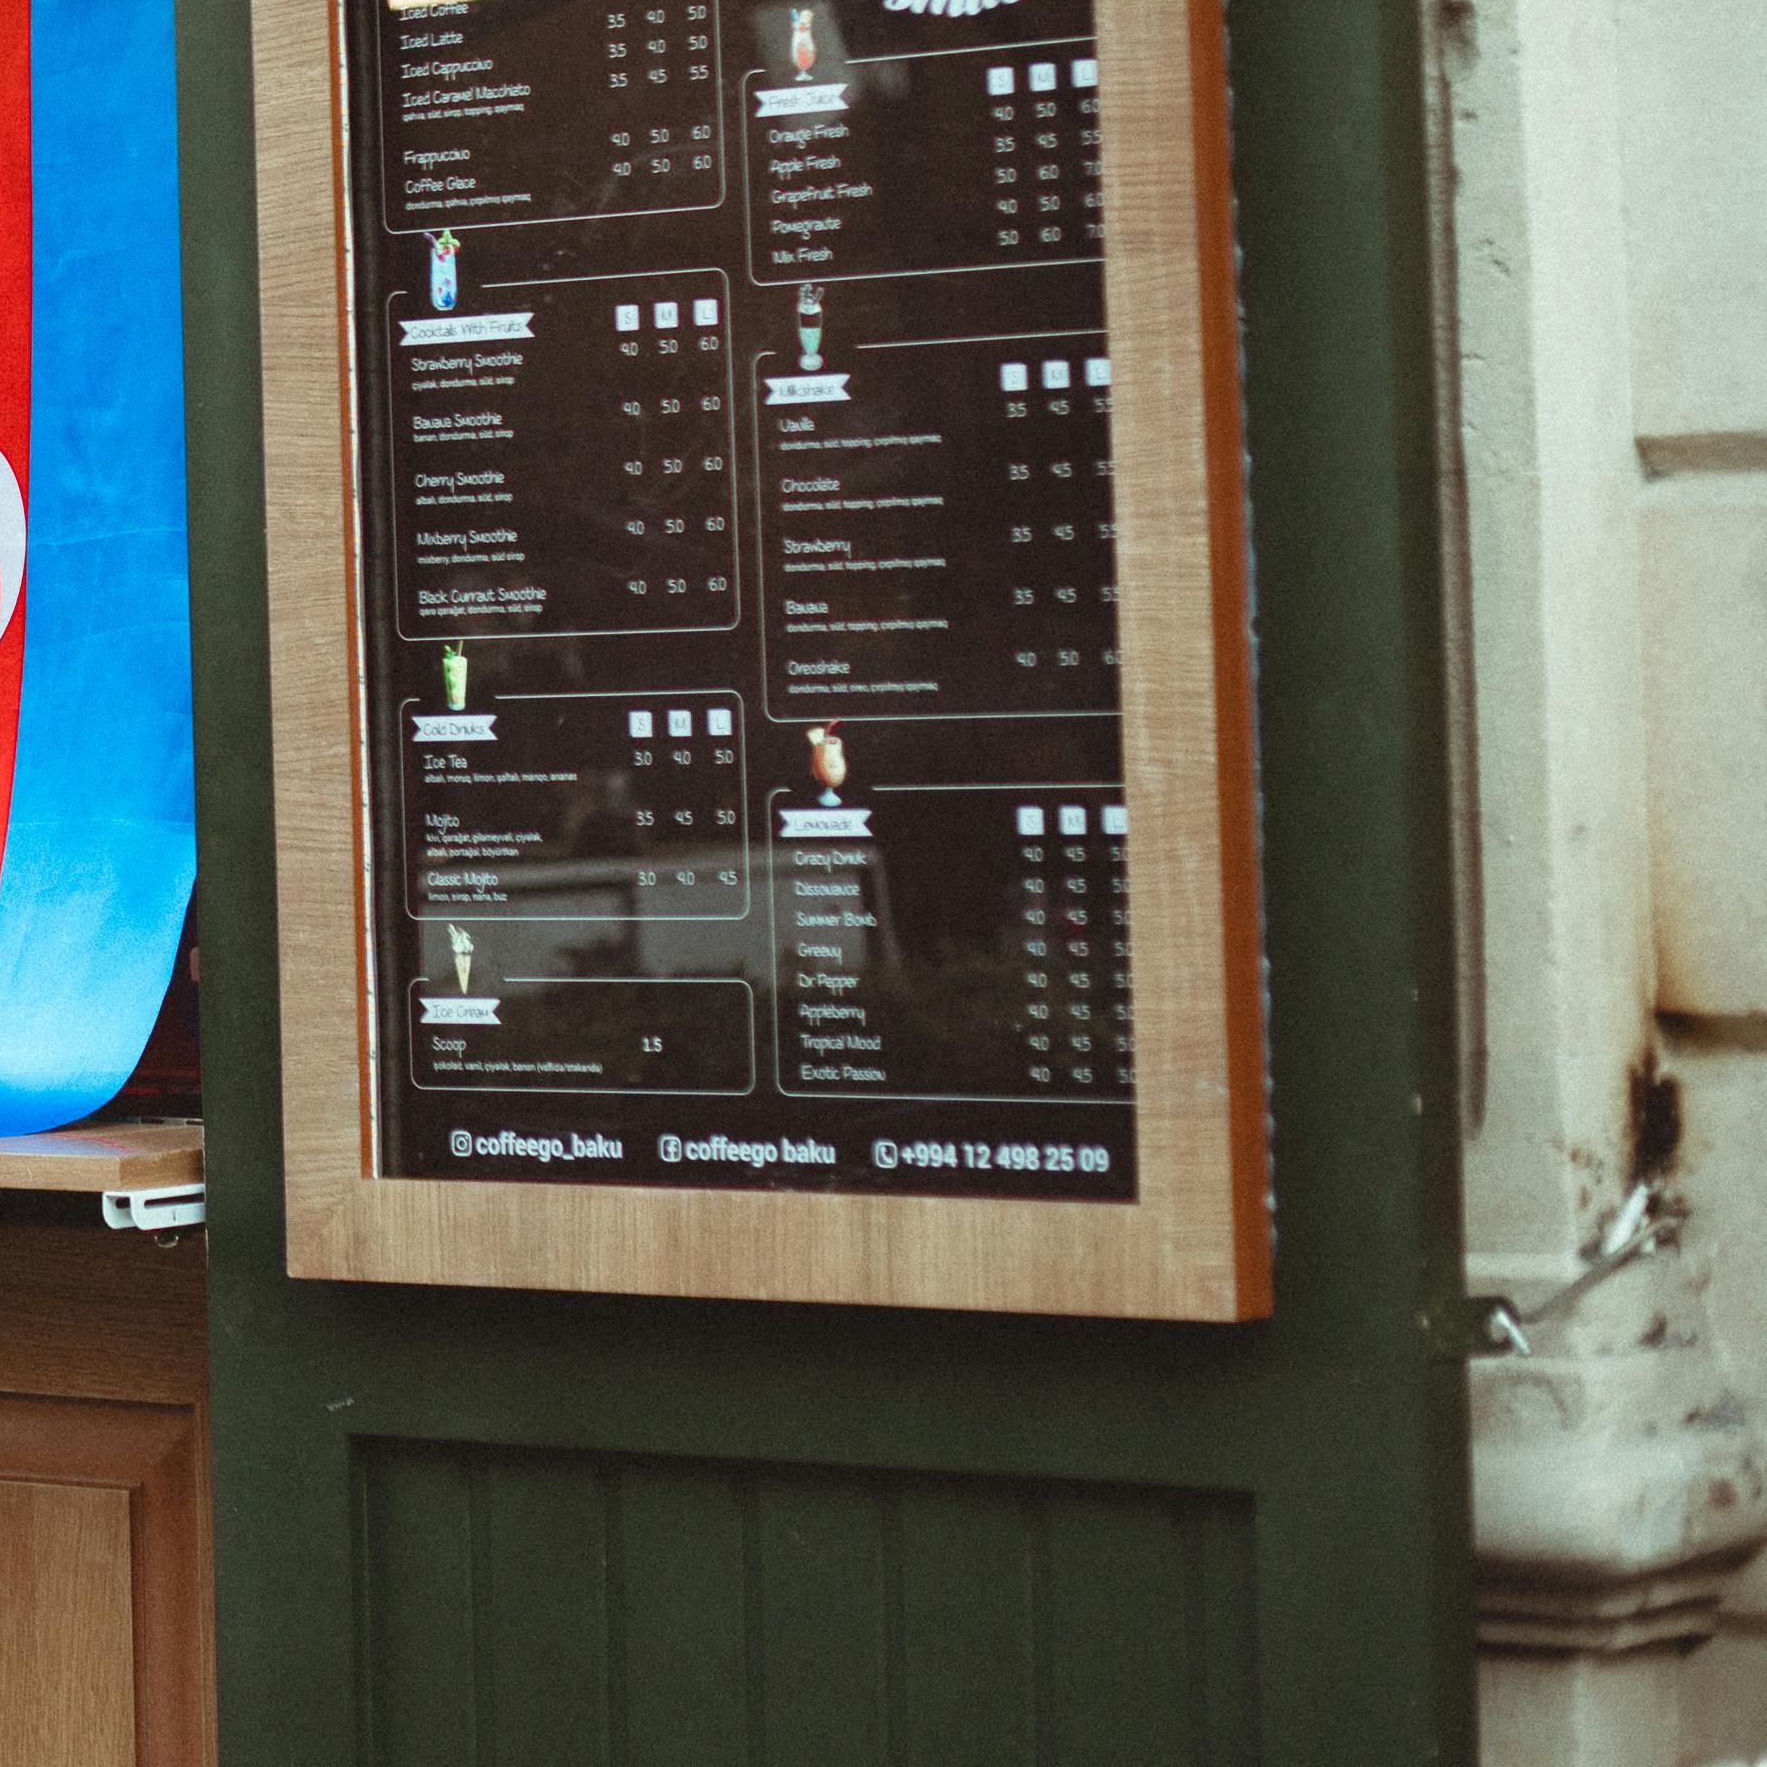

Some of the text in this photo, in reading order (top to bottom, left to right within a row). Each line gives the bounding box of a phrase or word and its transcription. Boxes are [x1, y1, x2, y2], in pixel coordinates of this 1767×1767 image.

[431, 32, 463, 47] Latte
[814, 124, 849, 139] Fresh
[771, 156, 841, 179] Apple Fresh
[405, 179, 444, 193] Coffee
[838, 183, 873, 198] Fresh
[798, 248, 833, 262] Fresh
[416, 474, 454, 493] Cherry
[782, 478, 840, 493] Chocolate
[784, 538, 851, 557] Strawberry
[419, 590, 448, 604] Black
[788, 661, 850, 675] Oreoshake
[423, 756, 445, 770] Ice
[448, 755, 467, 769] Tea
[426, 814, 459, 833] Mojito
[428, 873, 462, 886] Classic
[464, 873, 499, 894] Mojito
[433, 1005, 451, 1018] Ice
[433, 1037, 467, 1056] Scoop
[475, 1132, 623, 1162] coffeego_baku
[685, 1135, 836, 1168] coffeego baku
[901, 1142, 1109, 1172] +994 12 498 25 09
